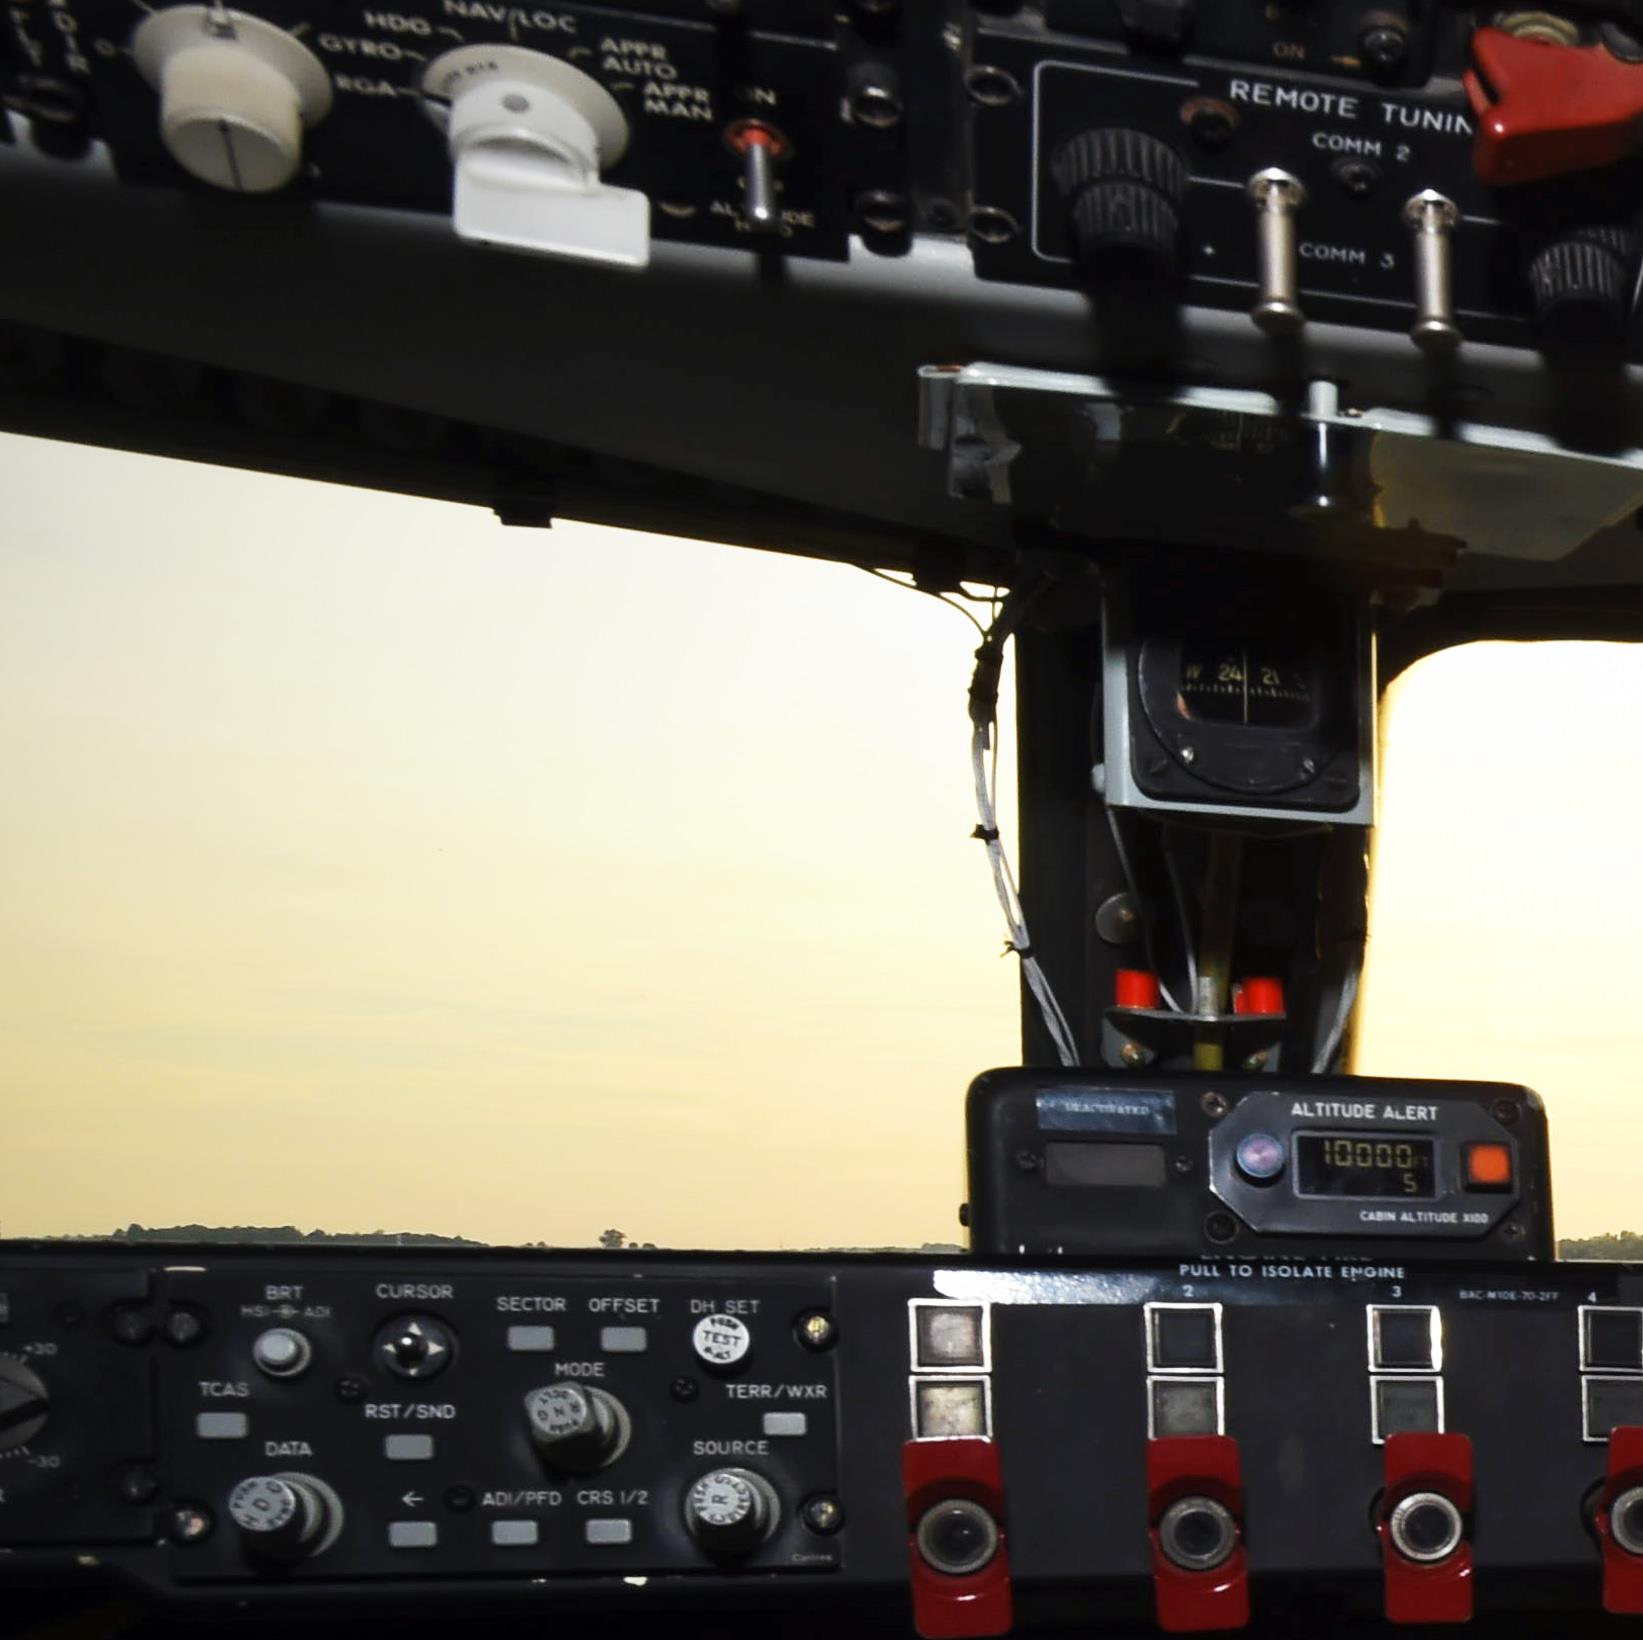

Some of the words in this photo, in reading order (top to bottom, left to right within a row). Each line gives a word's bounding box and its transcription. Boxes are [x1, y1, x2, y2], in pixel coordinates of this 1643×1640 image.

[365, 11, 432, 37] HDG
[444, 0, 577, 33] NAV/LOC
[319, 32, 402, 61] GYRO
[600, 36, 668, 60] APPR
[602, 58, 678, 82] AUTO
[643, 81, 712, 105] APPR
[643, 98, 714, 122] MAN
[1229, 79, 1360, 121] REMOTE
[1381, 102, 1474, 137] TUNIN
[1312, 130, 1383, 158] COMM
[1396, 143, 1412, 163] 2
[1299, 242, 1367, 267] COMM
[1379, 252, 1395, 270] 3
[1218, 664, 1243, 681] 24
[1261, 668, 1281, 686] 21
[1291, 1102, 1379, 1121] ALTITUDE
[1382, 1103, 1438, 1122] ALERT
[1322, 1139, 1413, 1168] 10000
[1359, 1210, 1396, 1223] CABIN
[1400, 1211, 1458, 1225] ALTITUDE
[1178, 1264, 1220, 1278] PULL
[1229, 1264, 1252, 1278] TO
[1261, 1265, 1335, 1280] ISOLATE
[1341, 1265, 1406, 1281] ENGINE
[264, 1285, 303, 1301] BRT
[376, 1284, 454, 1300] CURSOR
[496, 1297, 566, 1313] SECTOR
[589, 1298, 661, 1314] OFFSET
[690, 1299, 719, 1315] DH
[725, 1299, 761, 1315] SET
[703, 1331, 742, 1348] TEST
[555, 1362, 606, 1377] MODE
[199, 1382, 249, 1398] TCAS
[726, 1384, 828, 1399] TERR/WXR
[365, 1405, 456, 1420] RST/SND
[264, 1441, 313, 1457] DATA
[693, 1441, 770, 1456] SOURCE
[482, 1491, 562, 1508] ADI/PFD
[577, 1491, 613, 1506] CRS
[620, 1491, 648, 1506] 1/2
